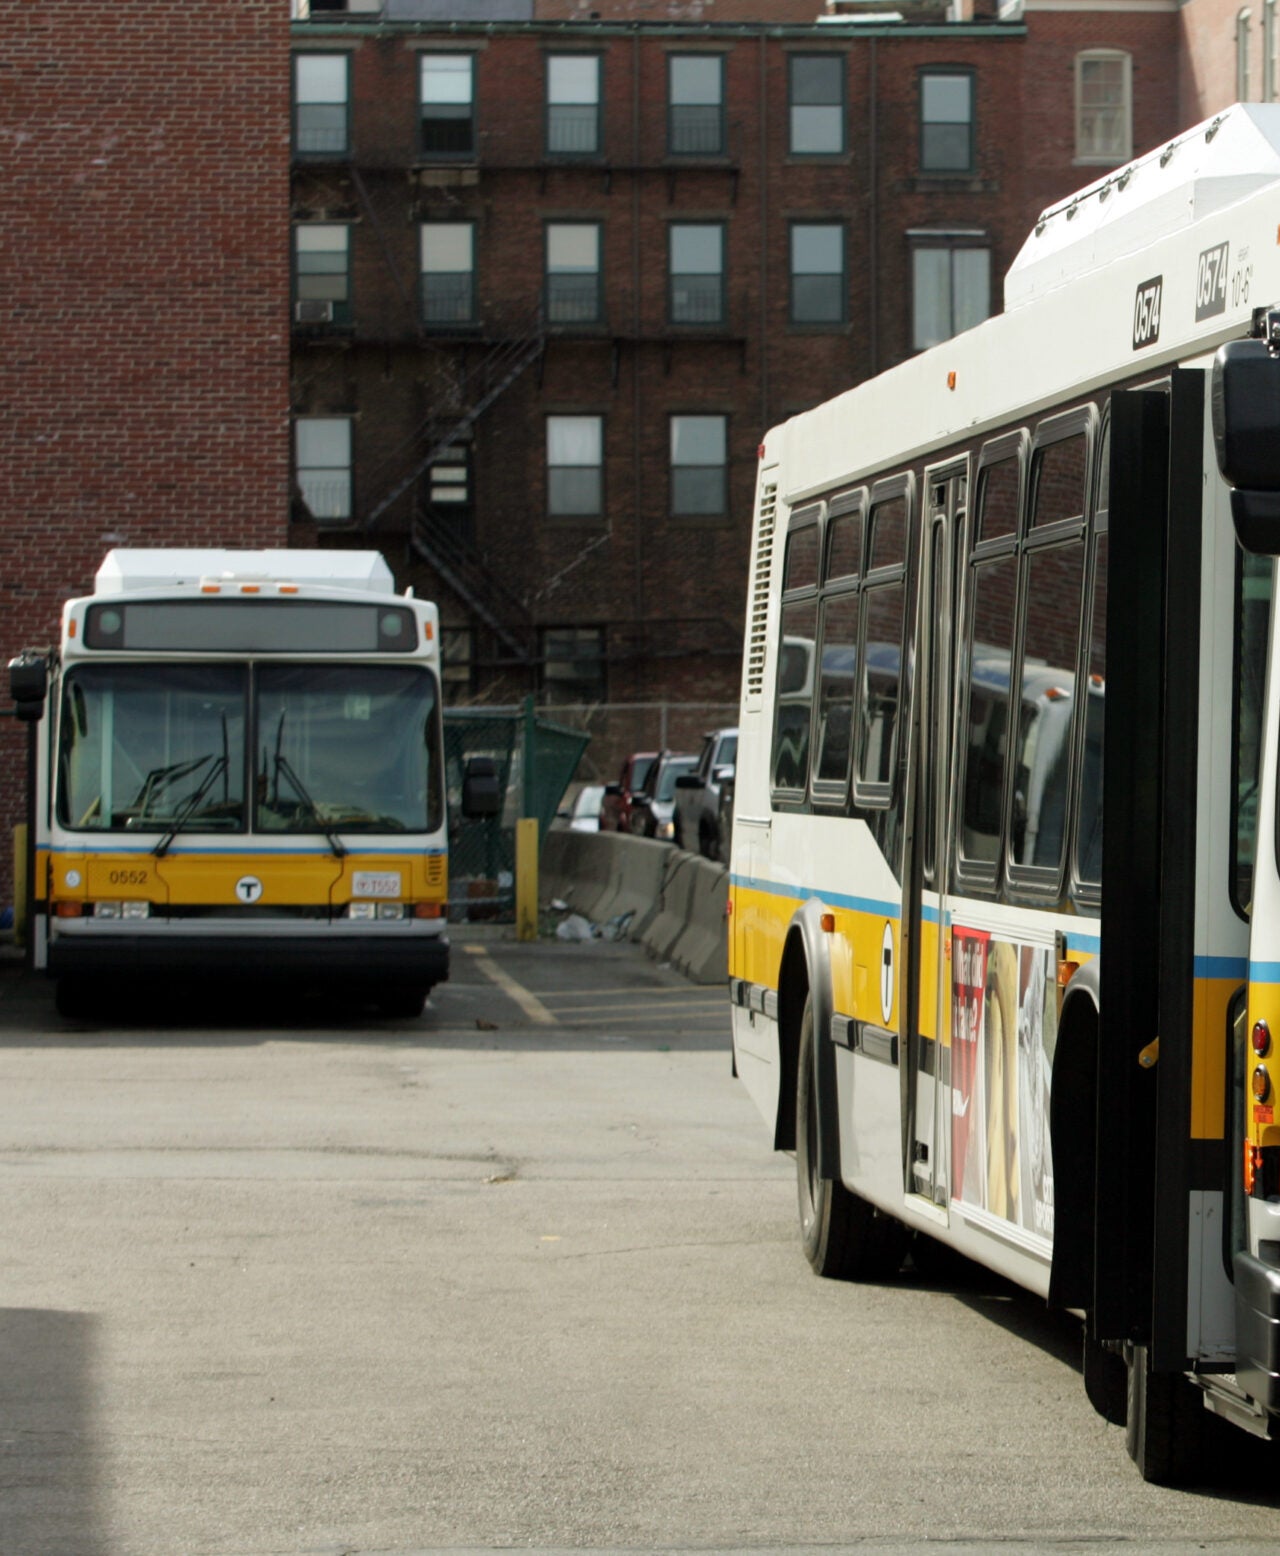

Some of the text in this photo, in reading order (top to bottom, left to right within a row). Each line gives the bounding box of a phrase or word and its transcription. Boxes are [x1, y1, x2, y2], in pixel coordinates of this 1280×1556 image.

[1197, 244, 1228, 309] 0574
[1133, 284, 1161, 344] 0574
[109, 870, 148, 885] 0552
